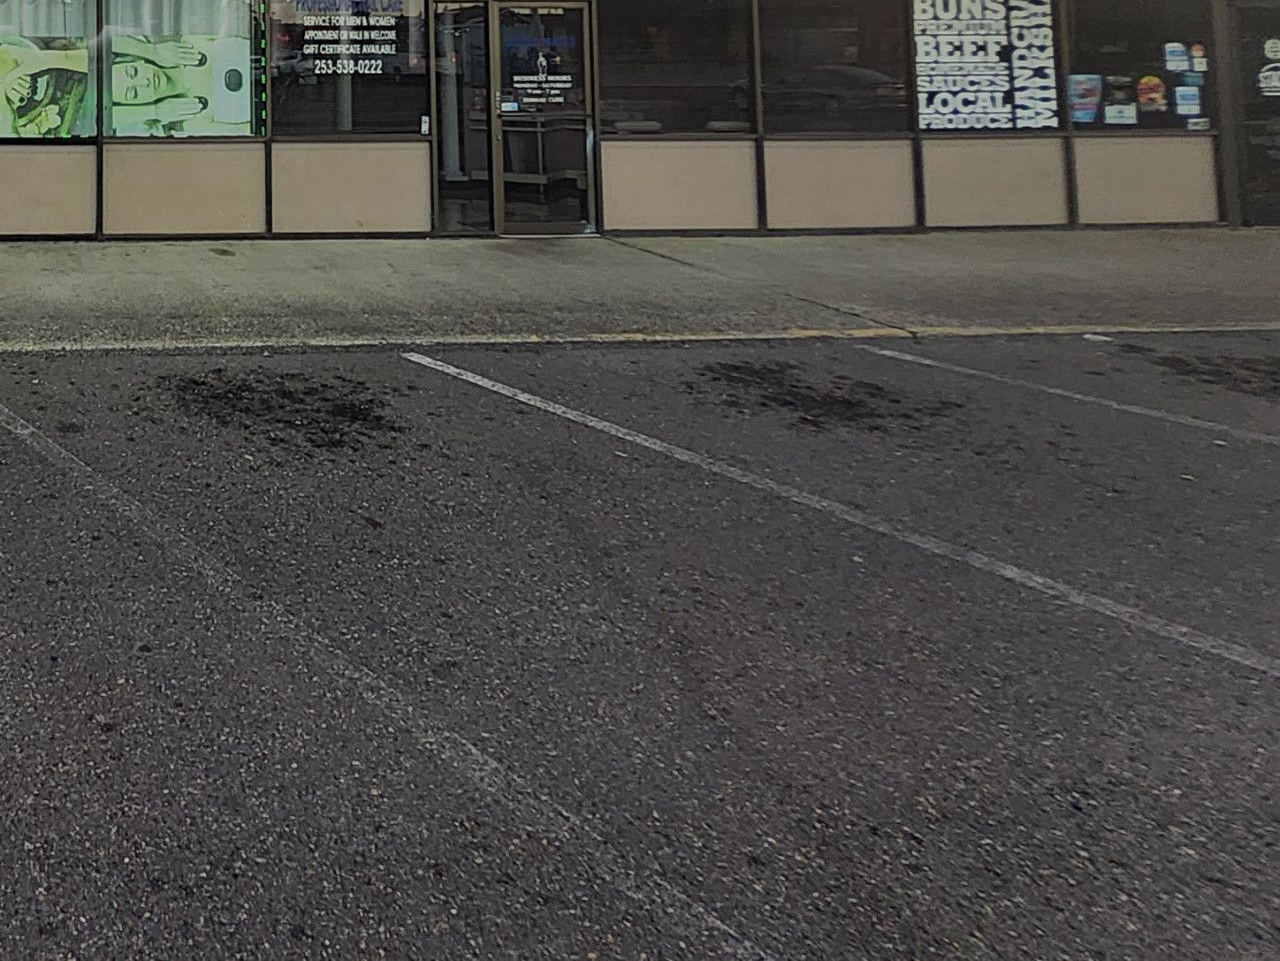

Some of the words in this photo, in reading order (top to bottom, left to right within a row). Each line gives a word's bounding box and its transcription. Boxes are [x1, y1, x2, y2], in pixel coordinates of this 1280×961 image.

[303, 16, 329, 26] SERVICE
[331, 16, 344, 26] FOR
[346, 16, 361, 26] MEN
[369, 16, 396, 26] WOMEN
[303, 44, 319, 54] GIFT
[320, 44, 361, 54] CERTIFICATE
[362, 44, 396, 54] AVAILABLE
[915, 35, 1008, 62] BEEF
[314, 60, 383, 74] 253-538-0222
[917, 76, 1010, 91] SAUCES
[918, 92, 1012, 113] LOCAL
